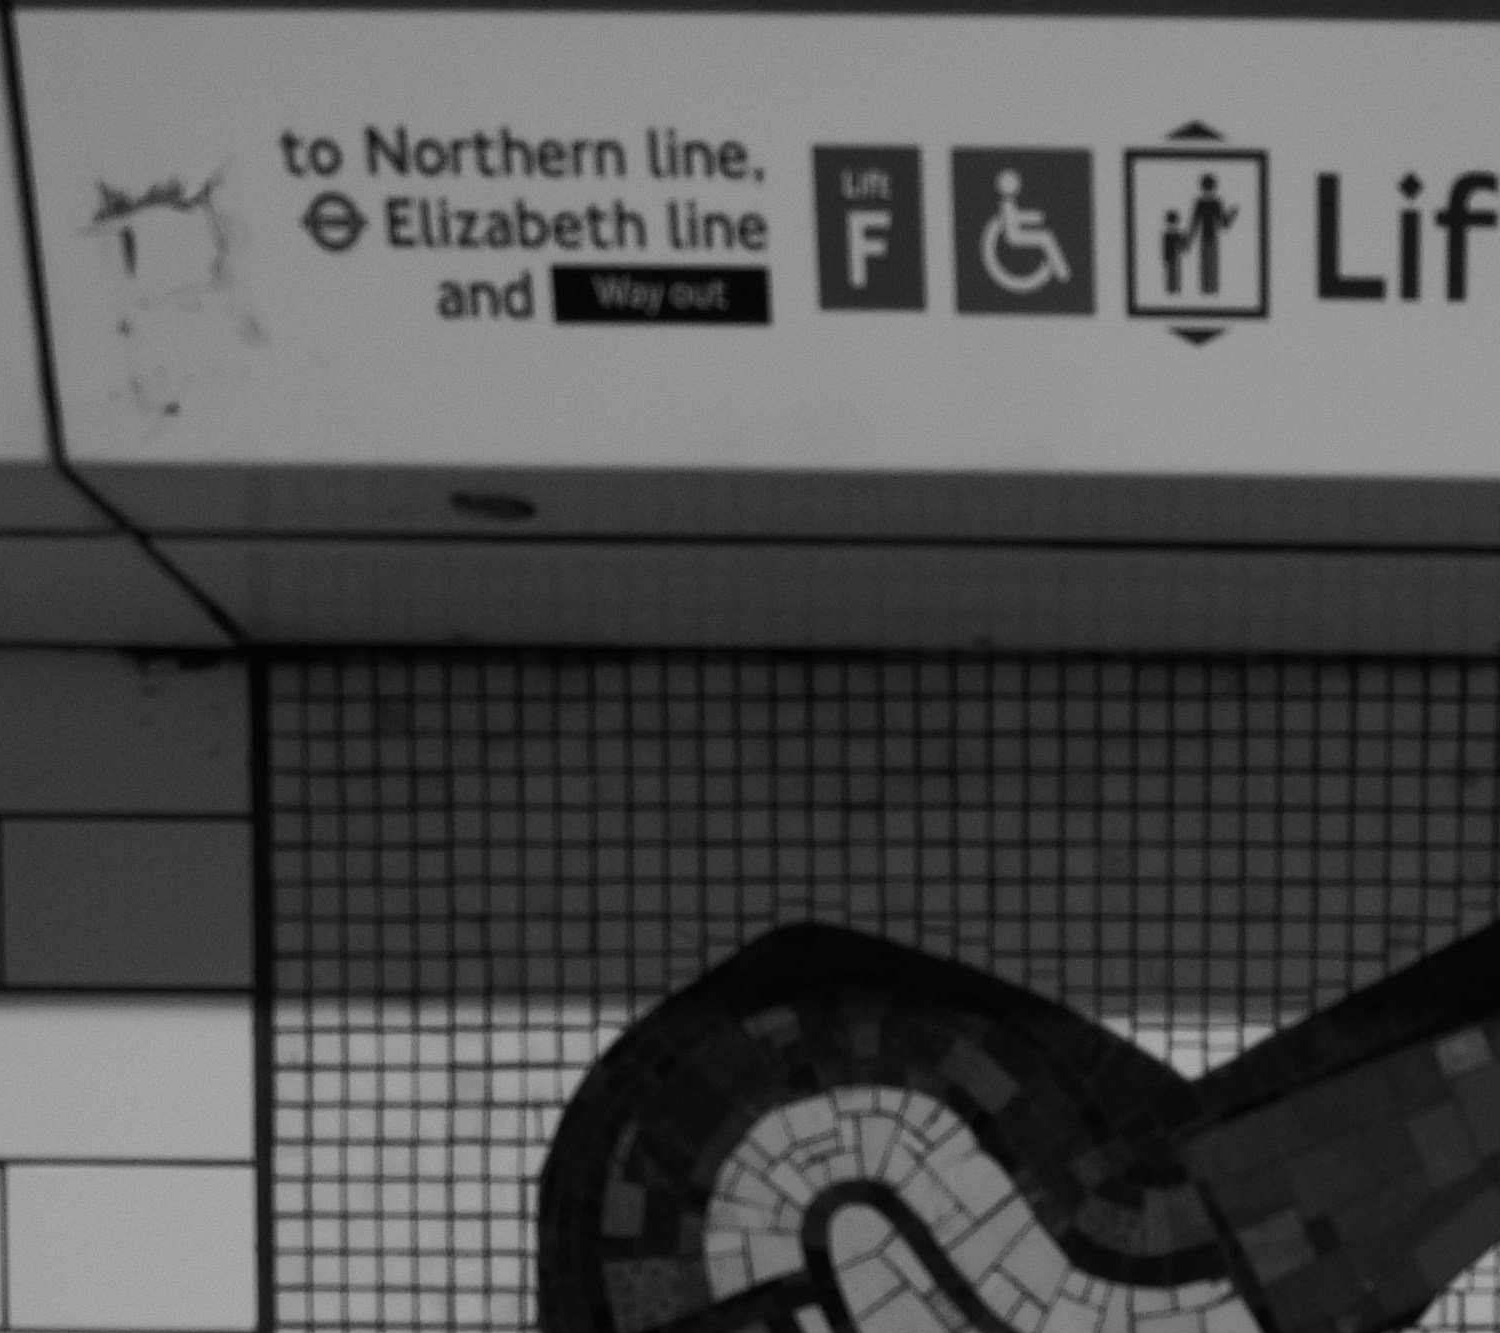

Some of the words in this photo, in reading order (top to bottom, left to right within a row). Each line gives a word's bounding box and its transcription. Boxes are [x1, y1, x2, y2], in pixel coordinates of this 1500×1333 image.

[280, 129, 342, 178] to
[365, 125, 627, 178] Northern
[647, 127, 766, 183] line,
[385, 197, 646, 250] Elizabeth
[668, 198, 768, 251] line
[845, 209, 893, 290] F
[438, 268, 535, 320] and
[589, 272, 665, 318] Way
[666, 276, 731, 312] out
